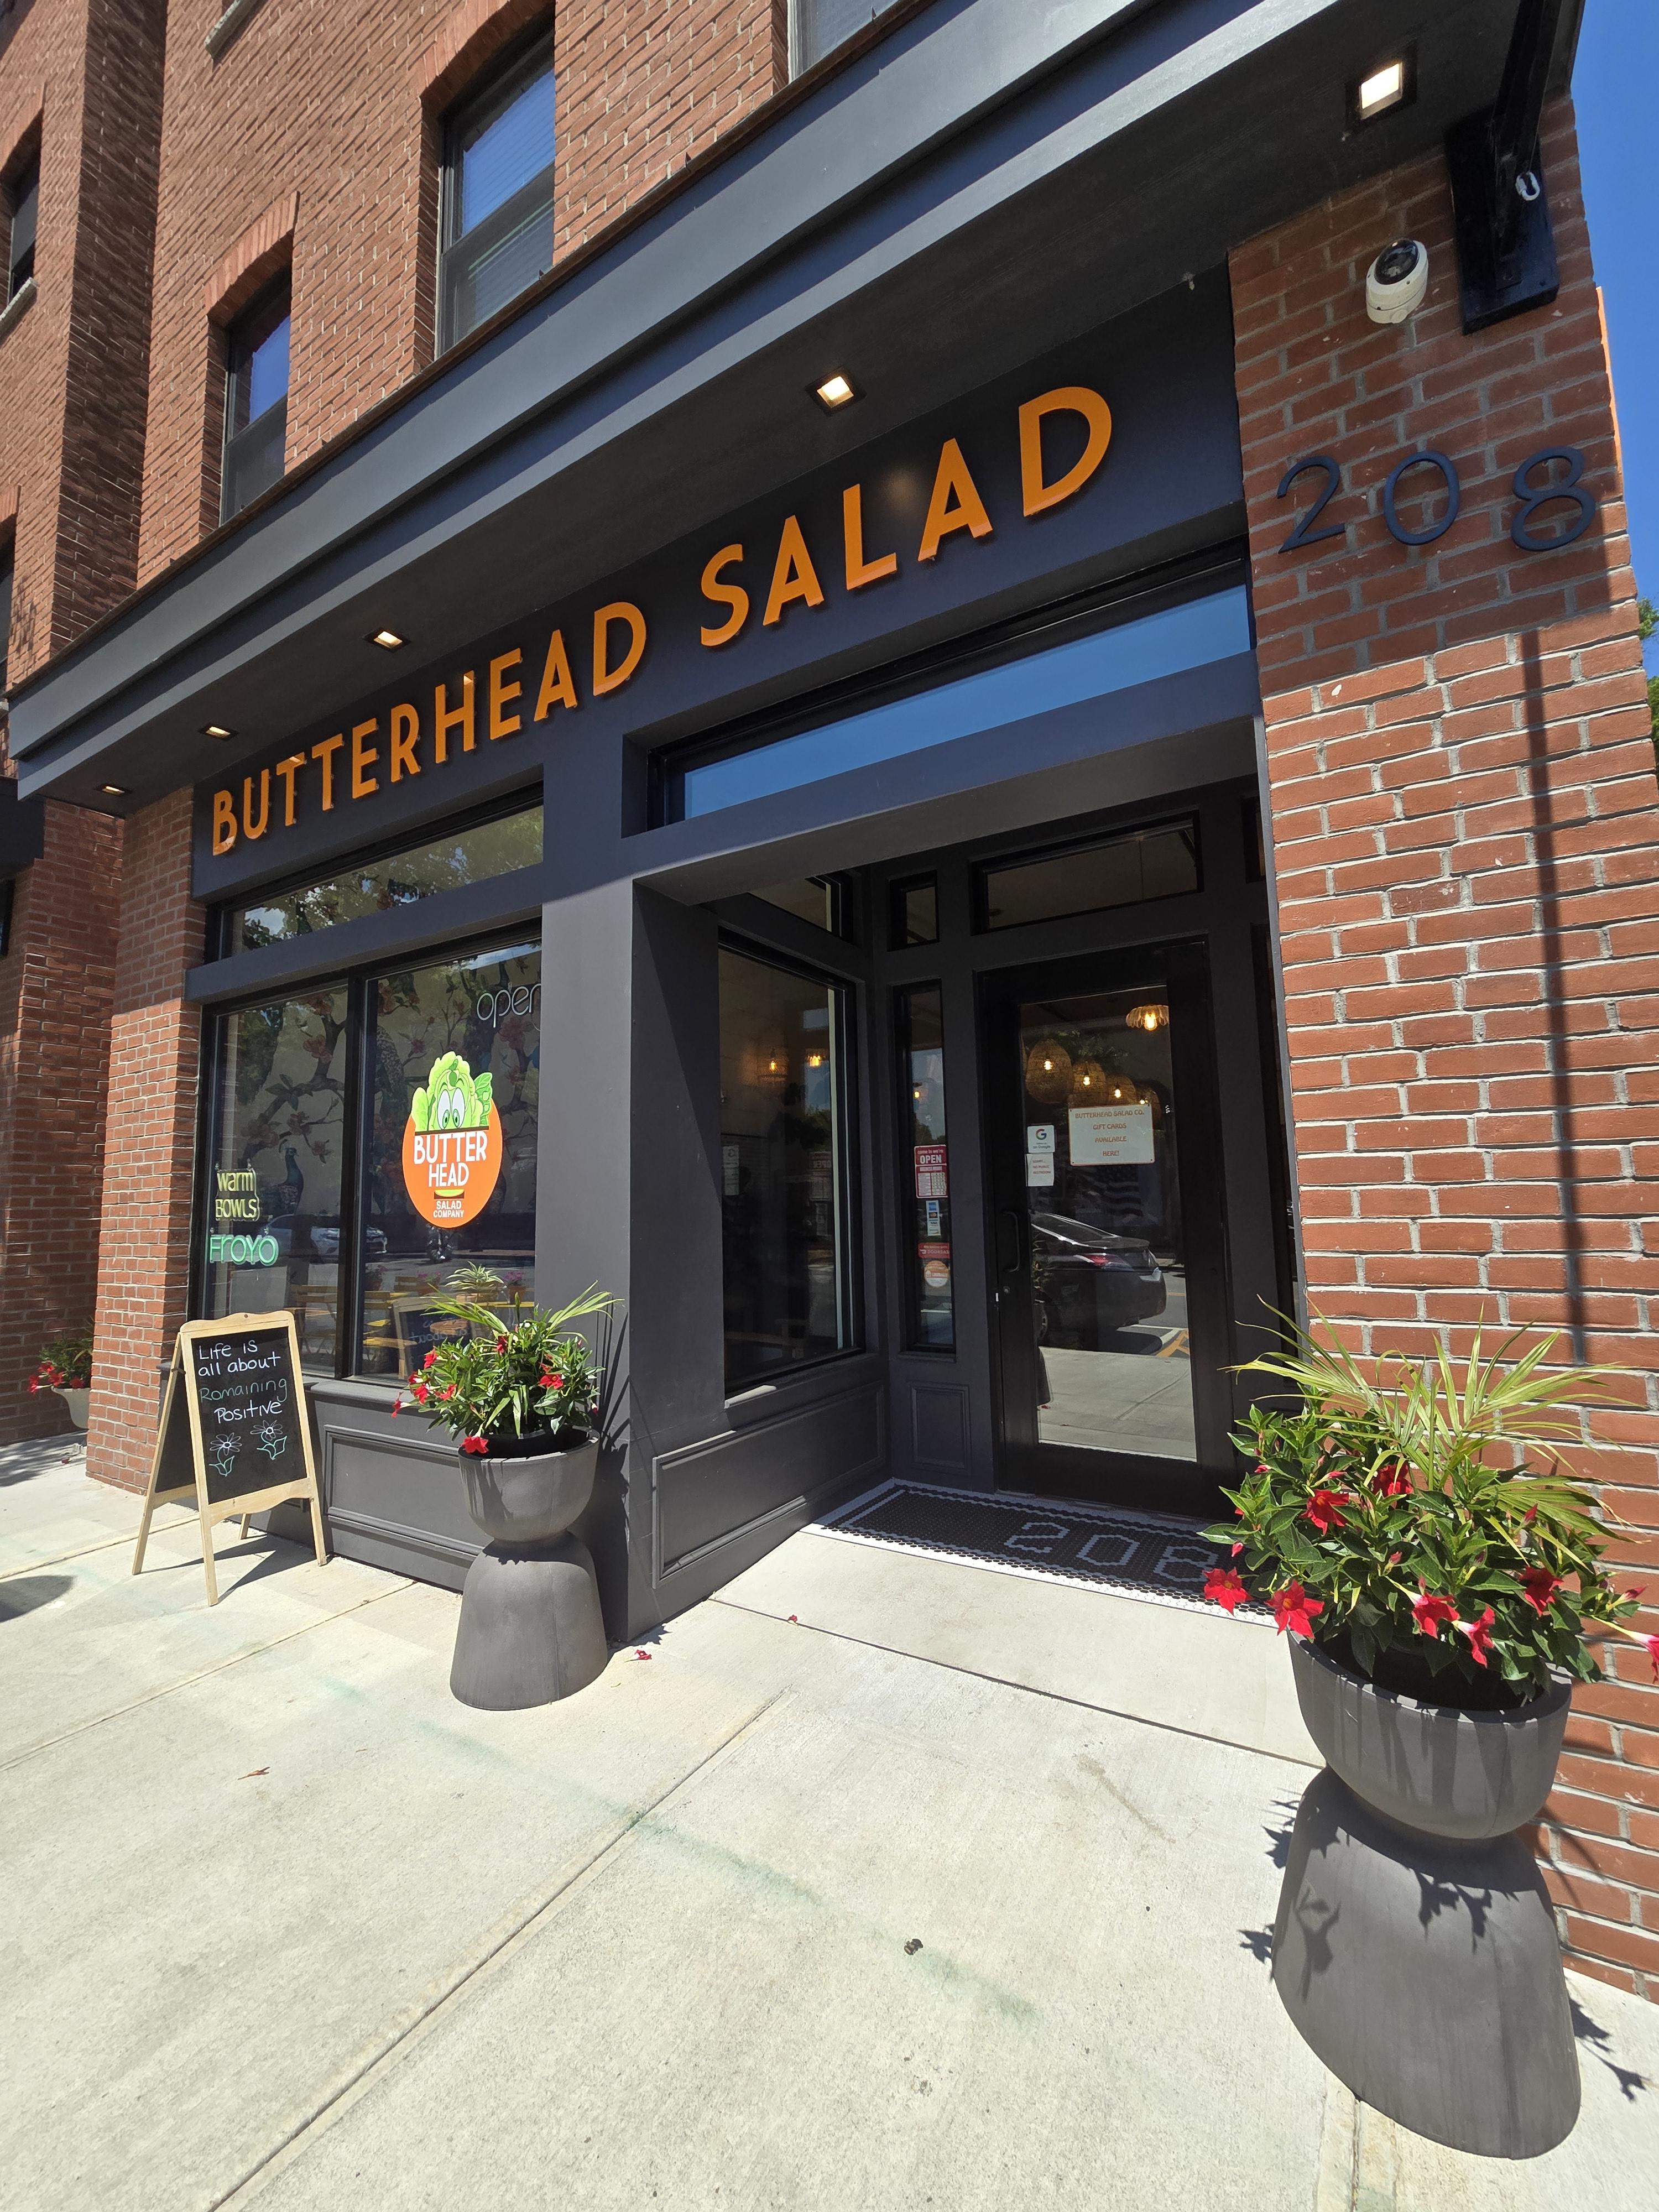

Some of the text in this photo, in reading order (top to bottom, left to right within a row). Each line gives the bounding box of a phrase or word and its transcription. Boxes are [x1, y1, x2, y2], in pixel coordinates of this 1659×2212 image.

[1276, 447, 1596, 554] 208
[212, 386, 1112, 856] BUTTERHEAD SALAD
[1036, 1129, 1047, 1140] G
[414, 1131, 488, 1164] BUTTER
[920, 1154, 942, 1164] OPEN
[429, 1162, 469, 1187] HEAD
[215, 1199, 257, 1218] BOWLS
[436, 1200, 462, 1210] SALAD
[198, 1351, 281, 1376] all about
[199, 1378, 288, 1403] Romaining
